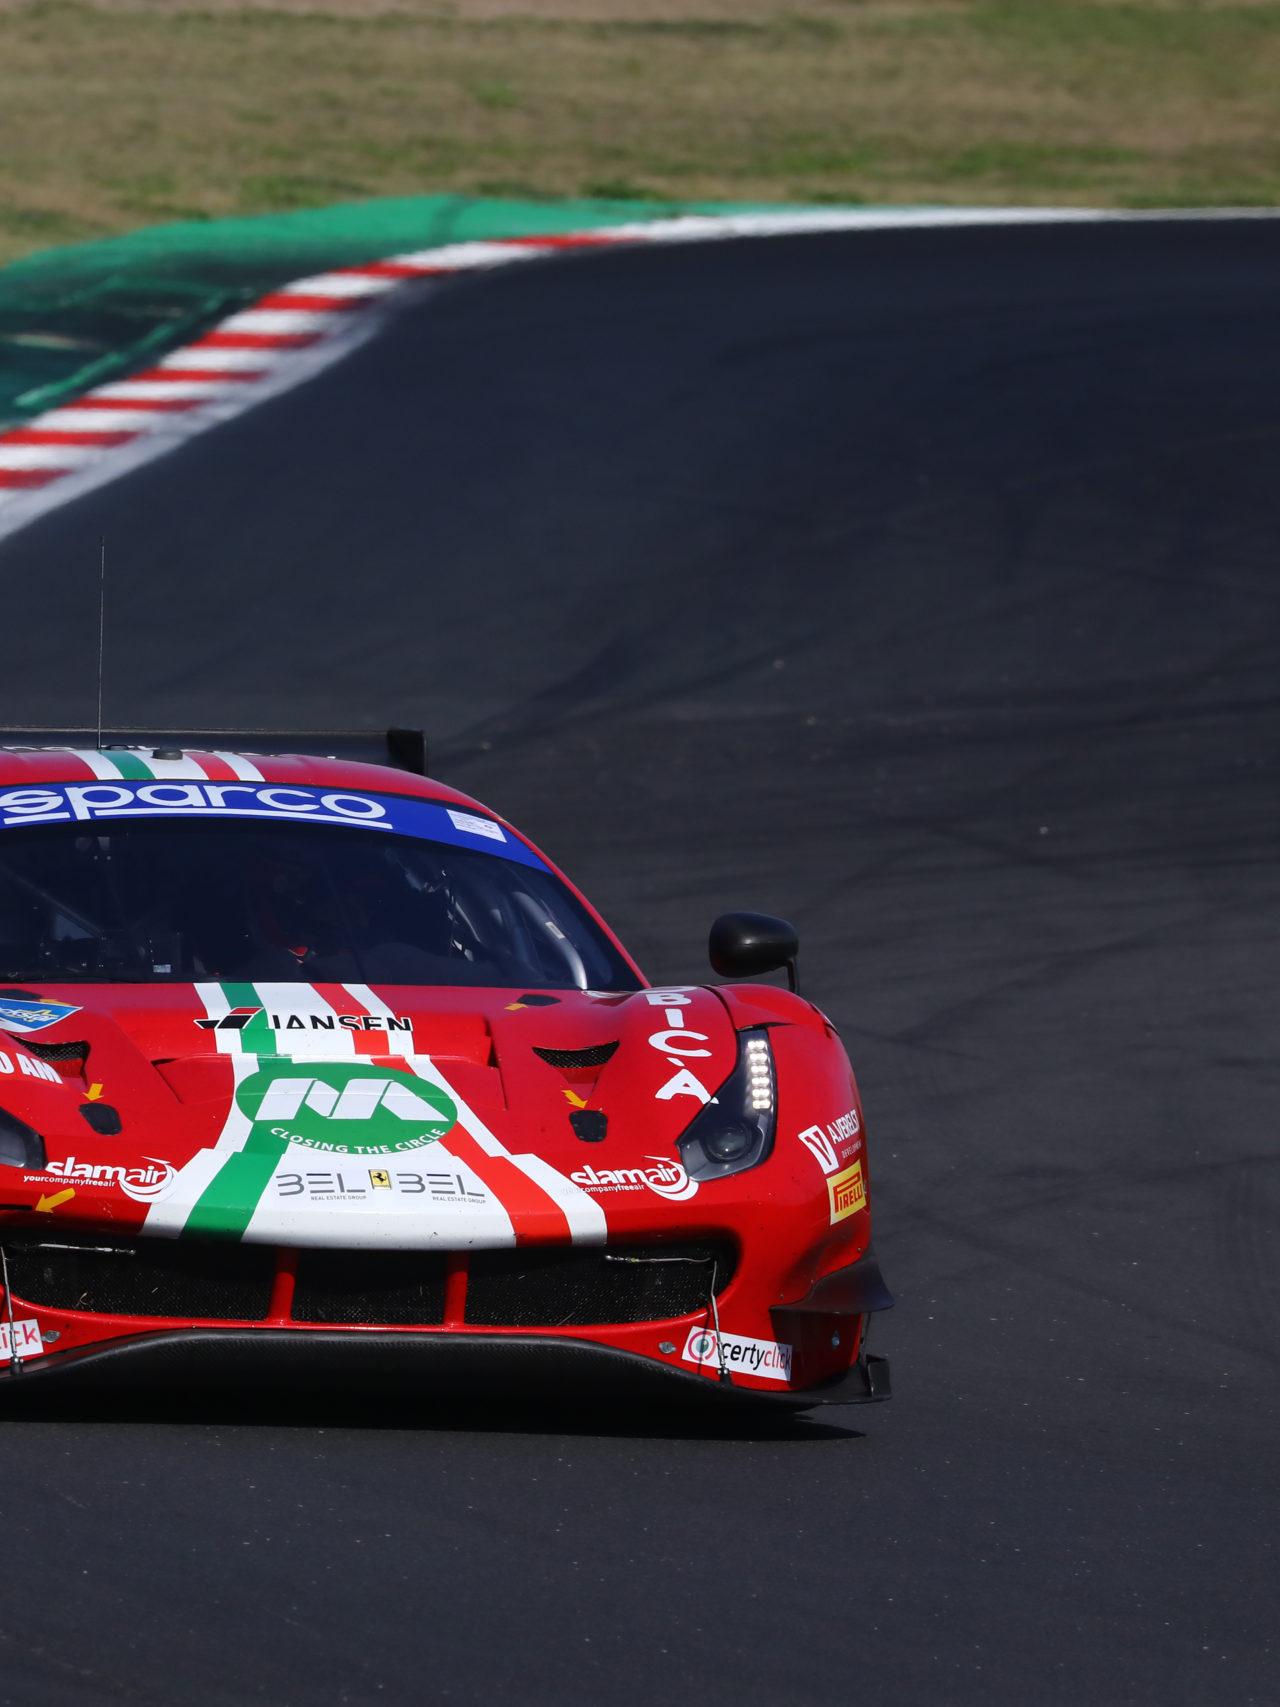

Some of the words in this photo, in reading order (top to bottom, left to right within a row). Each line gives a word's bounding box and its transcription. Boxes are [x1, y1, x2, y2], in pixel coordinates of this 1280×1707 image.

[15, 1053, 64, 1084] AM
[270, 1127, 348, 1154] CLOSING
[354, 1145, 392, 1154] THE
[395, 1128, 447, 1152] CIRCLE
[23, 1174, 116, 1187] yourcompanyfreeair
[45, 1156, 168, 1184] slamair
[570, 1163, 678, 1186] slamair
[832, 1171, 864, 1214] PIRELLI
